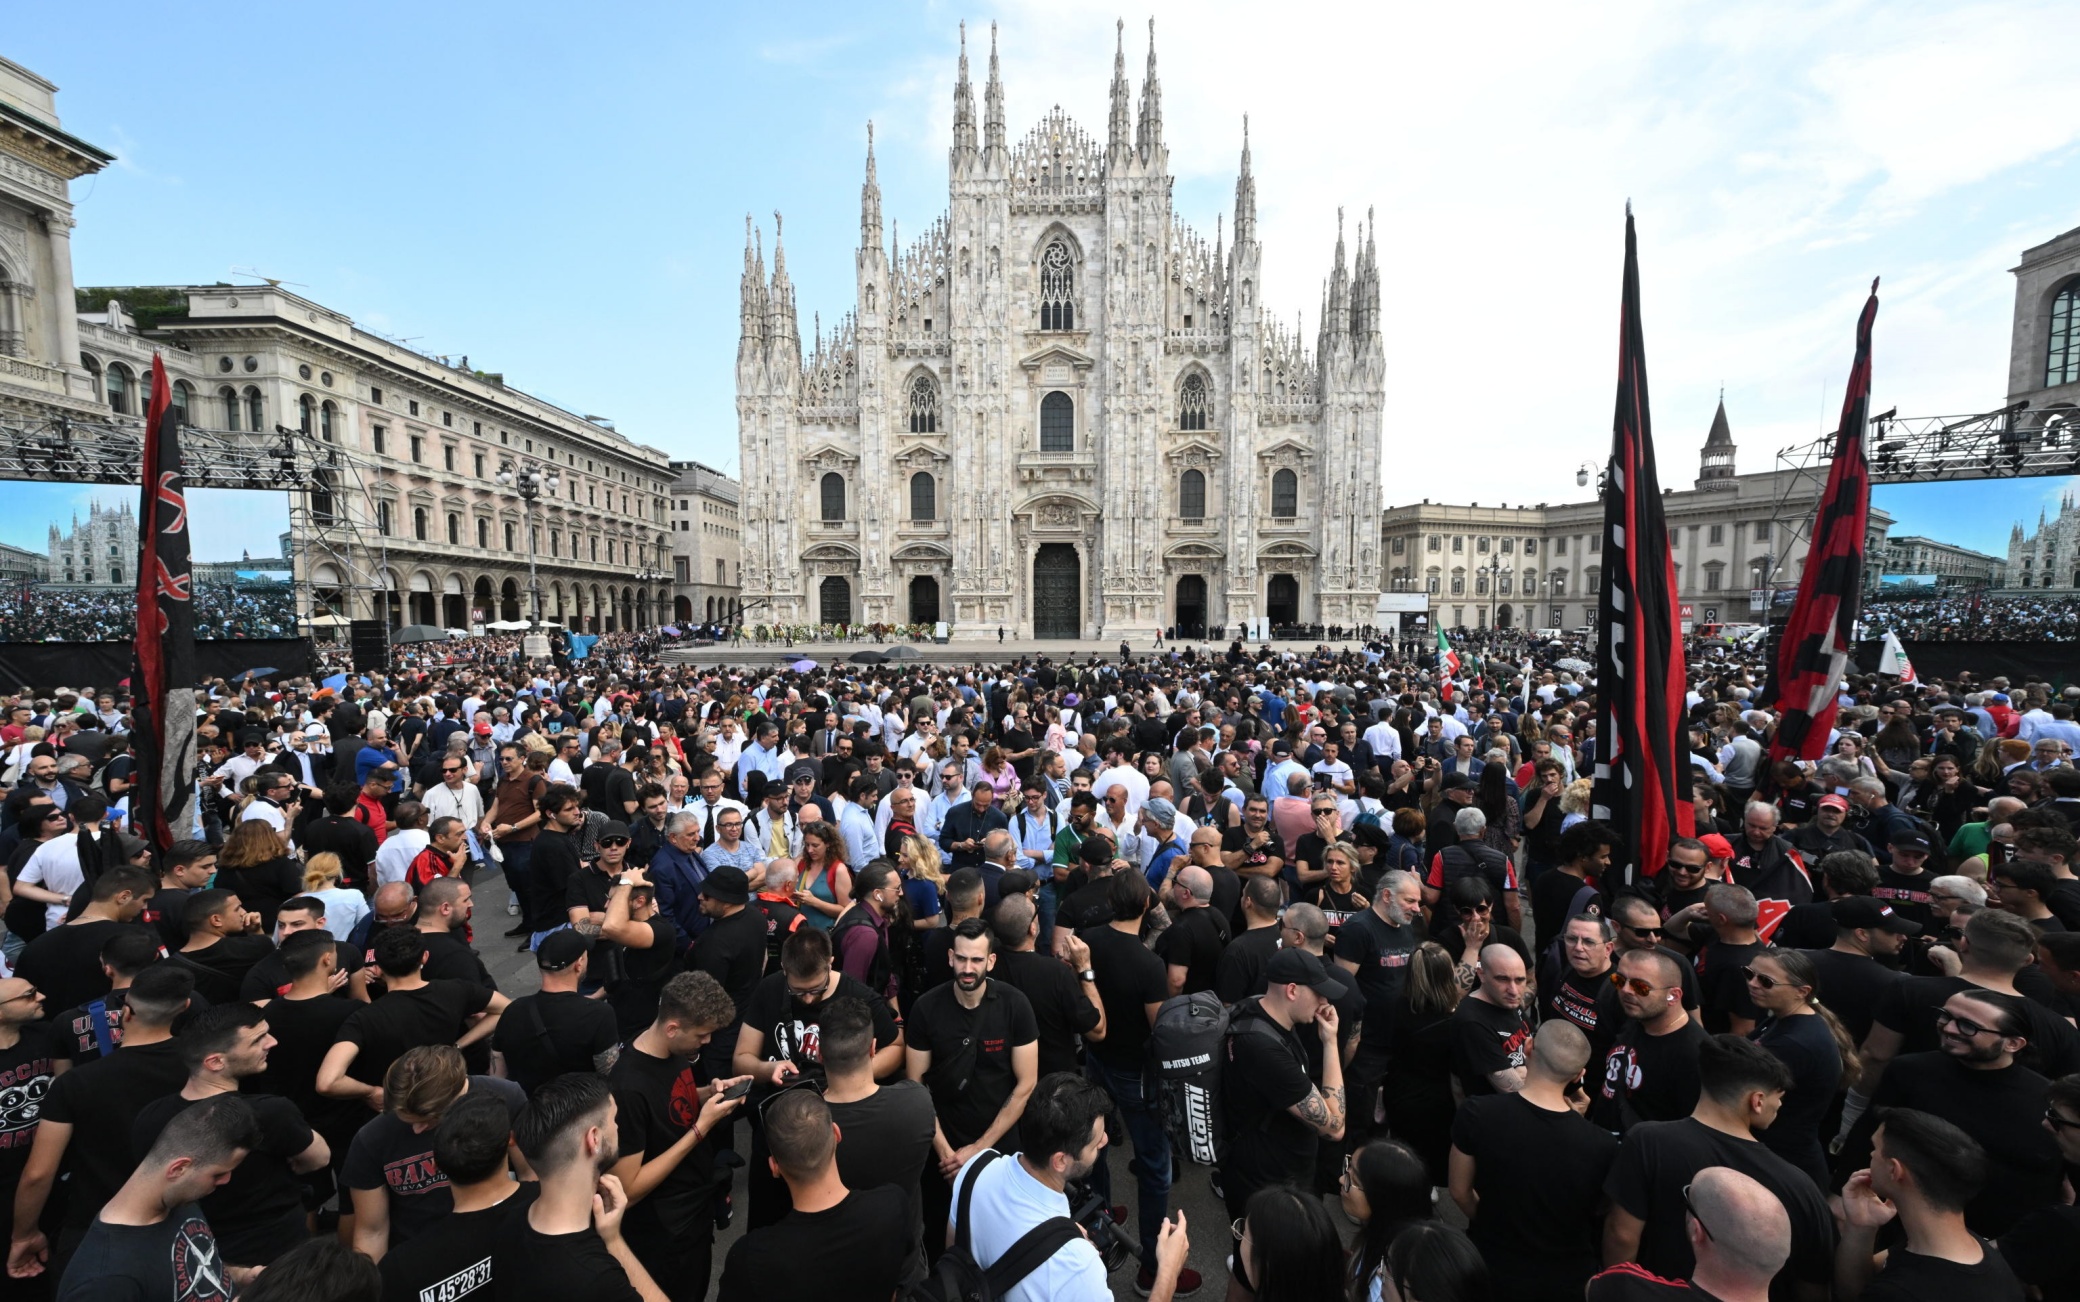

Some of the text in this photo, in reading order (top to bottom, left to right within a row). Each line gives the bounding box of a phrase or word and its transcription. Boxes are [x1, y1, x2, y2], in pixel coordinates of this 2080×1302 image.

[472, 610, 483, 619] M
[1681, 607, 1692, 615] M
[1190, 1053, 1211, 1066] TEAM
[425, 1174, 448, 1187] SUD
